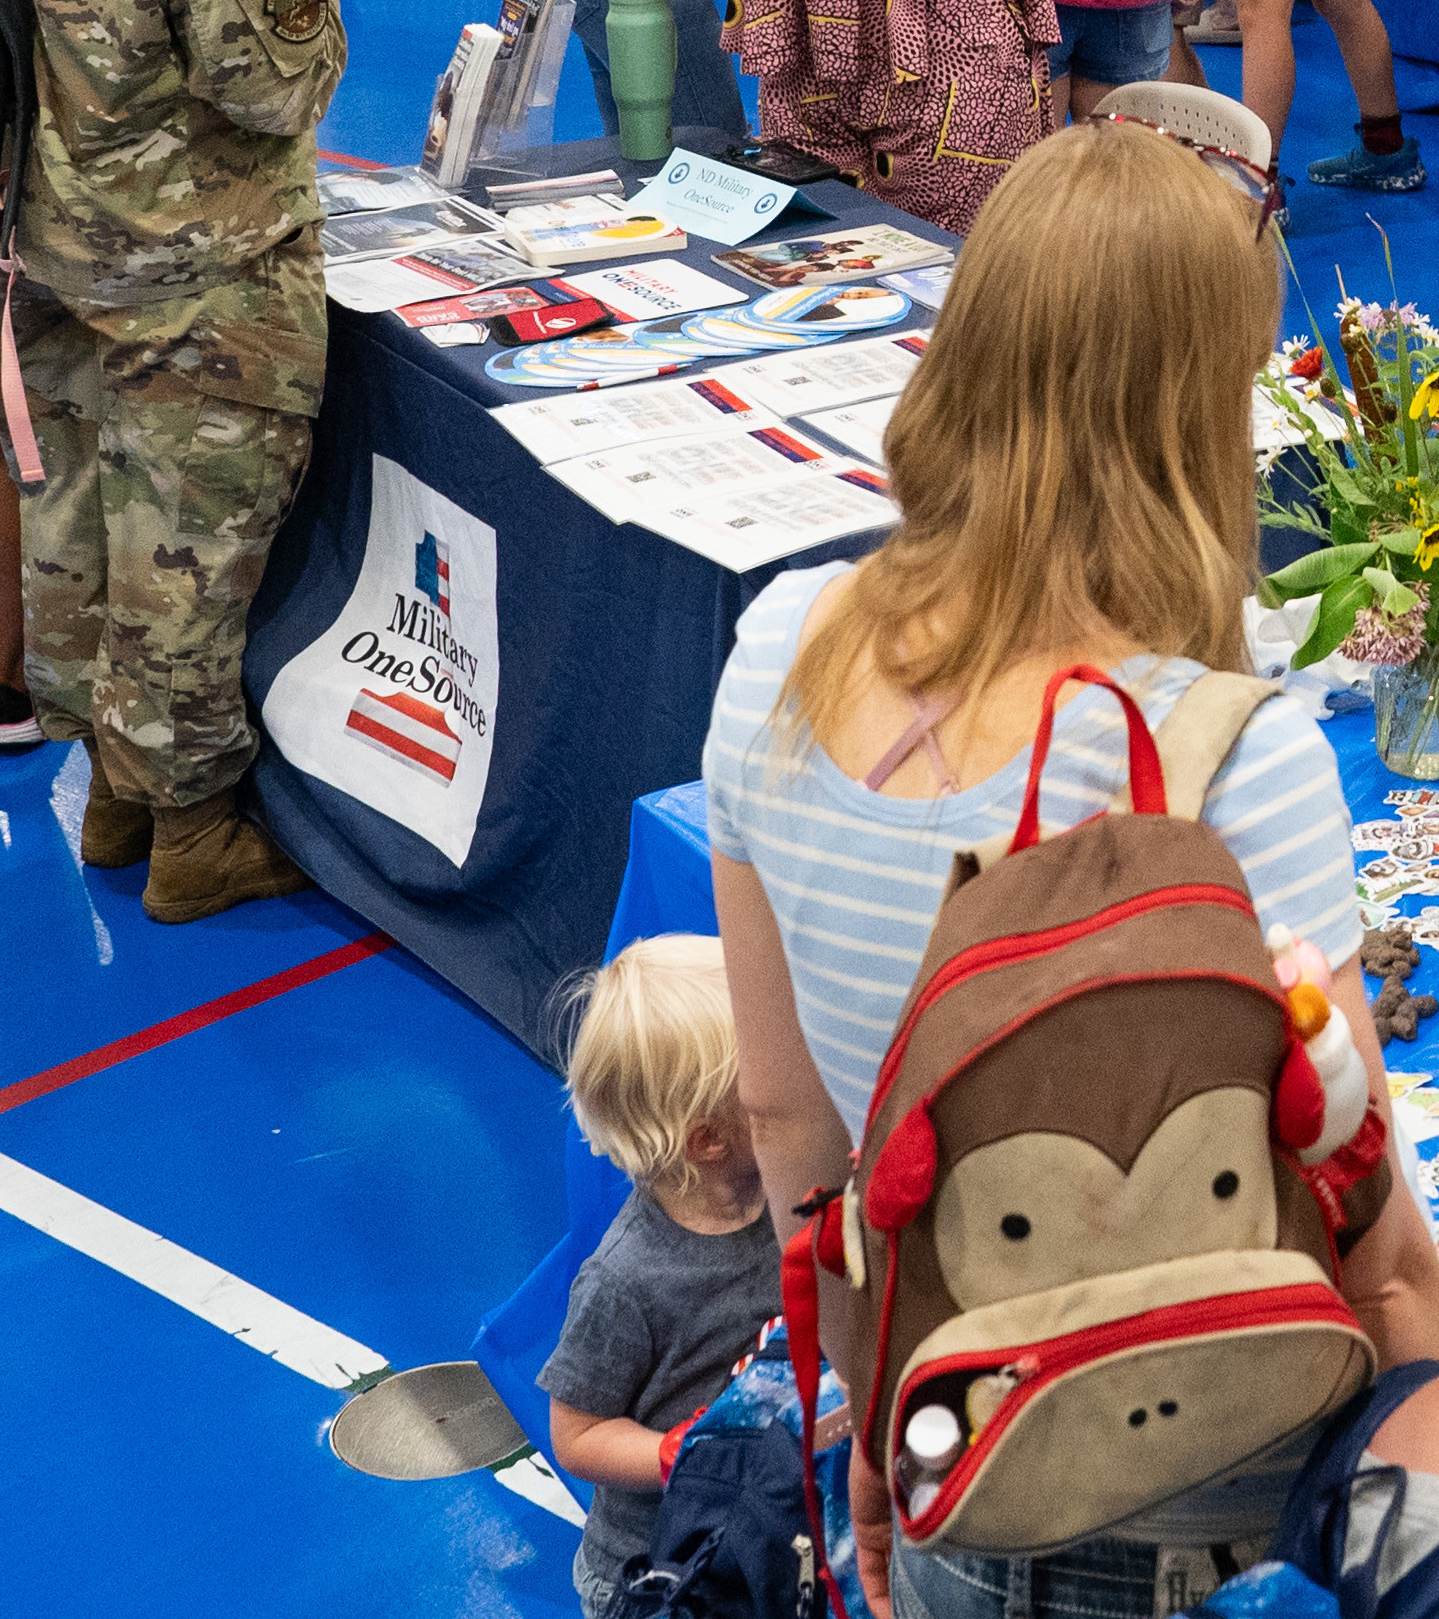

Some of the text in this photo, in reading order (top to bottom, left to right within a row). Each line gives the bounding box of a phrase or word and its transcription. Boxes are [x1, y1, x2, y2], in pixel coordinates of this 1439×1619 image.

[696, 167, 754, 200] ND Military
[684, 189, 735, 214] OneSource
[602, 273, 682, 310] ONESOURCE
[622, 269, 679, 294] MILITARY
[386, 593, 478, 688] Military
[341, 631, 487, 737] OneSource
